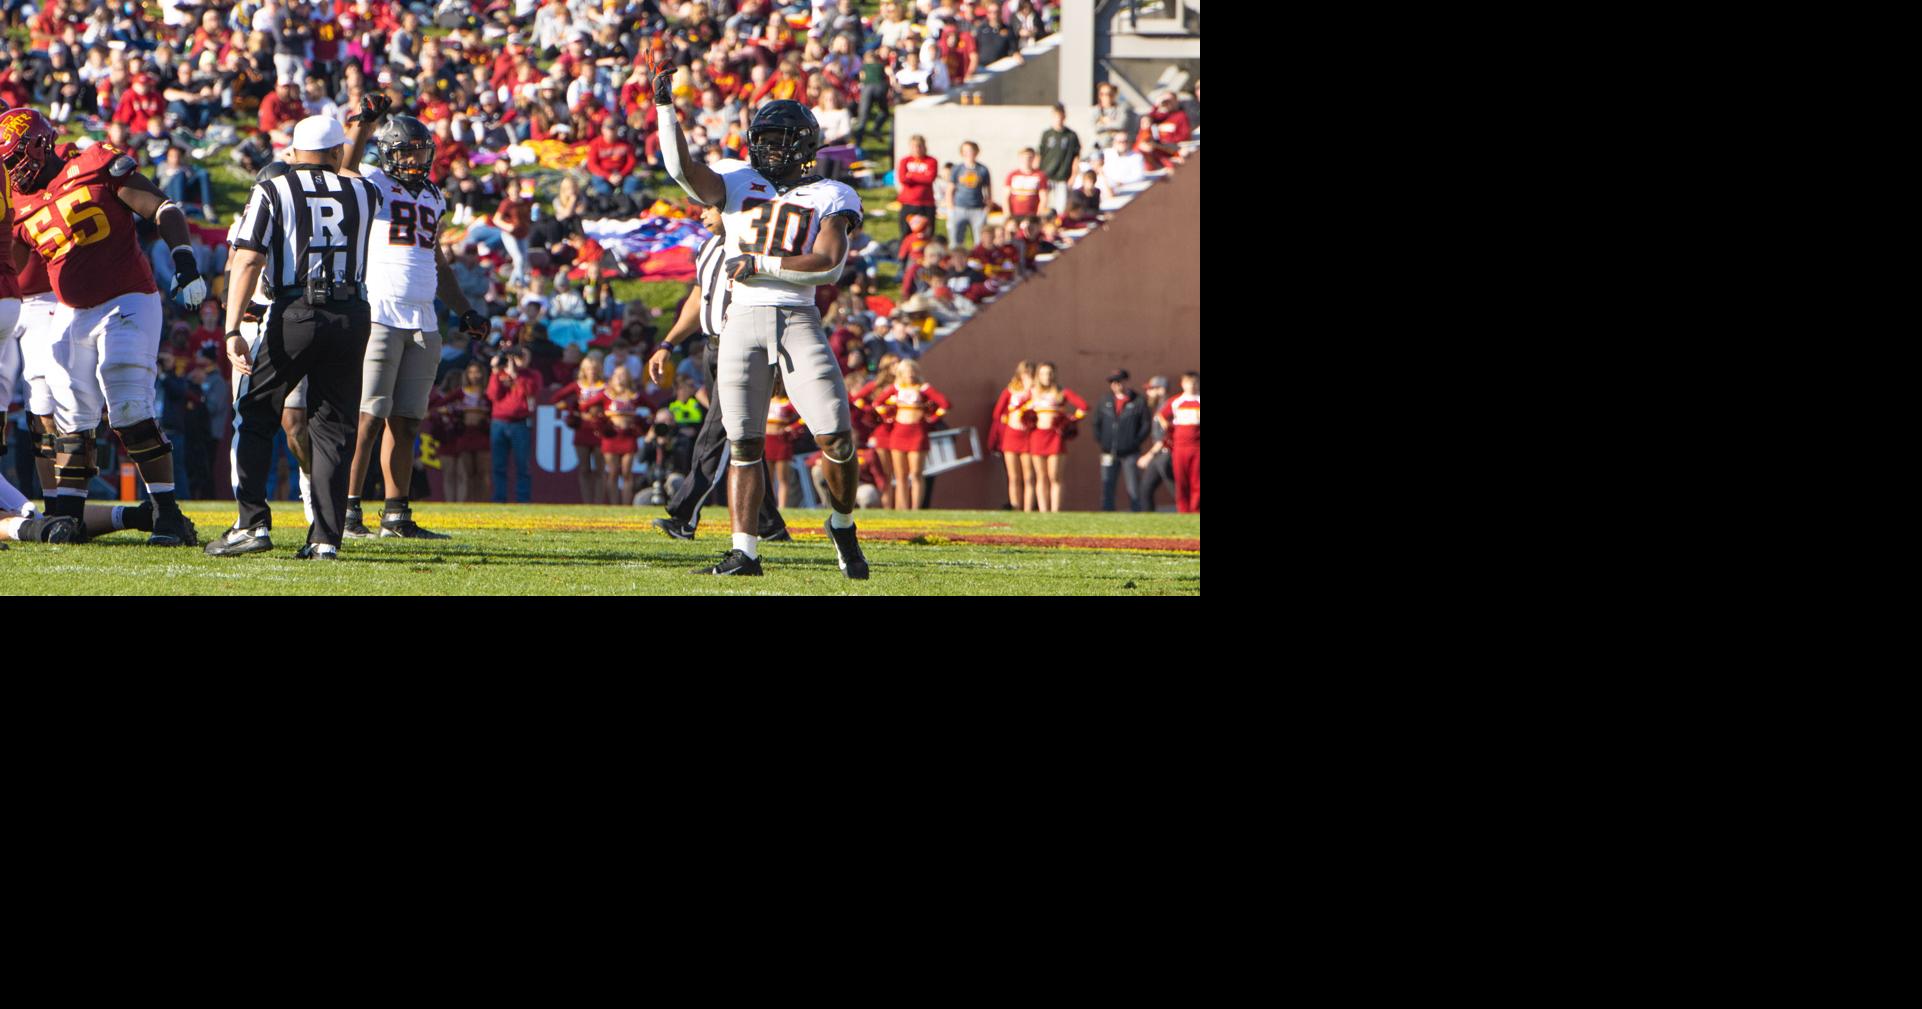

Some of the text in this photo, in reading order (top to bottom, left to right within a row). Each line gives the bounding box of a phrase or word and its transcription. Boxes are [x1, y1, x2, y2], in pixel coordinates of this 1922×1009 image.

[23, 186, 111, 260] 55
[306, 197, 348, 247] R
[389, 200, 437, 249] 89
[739, 197, 815, 258] 30
